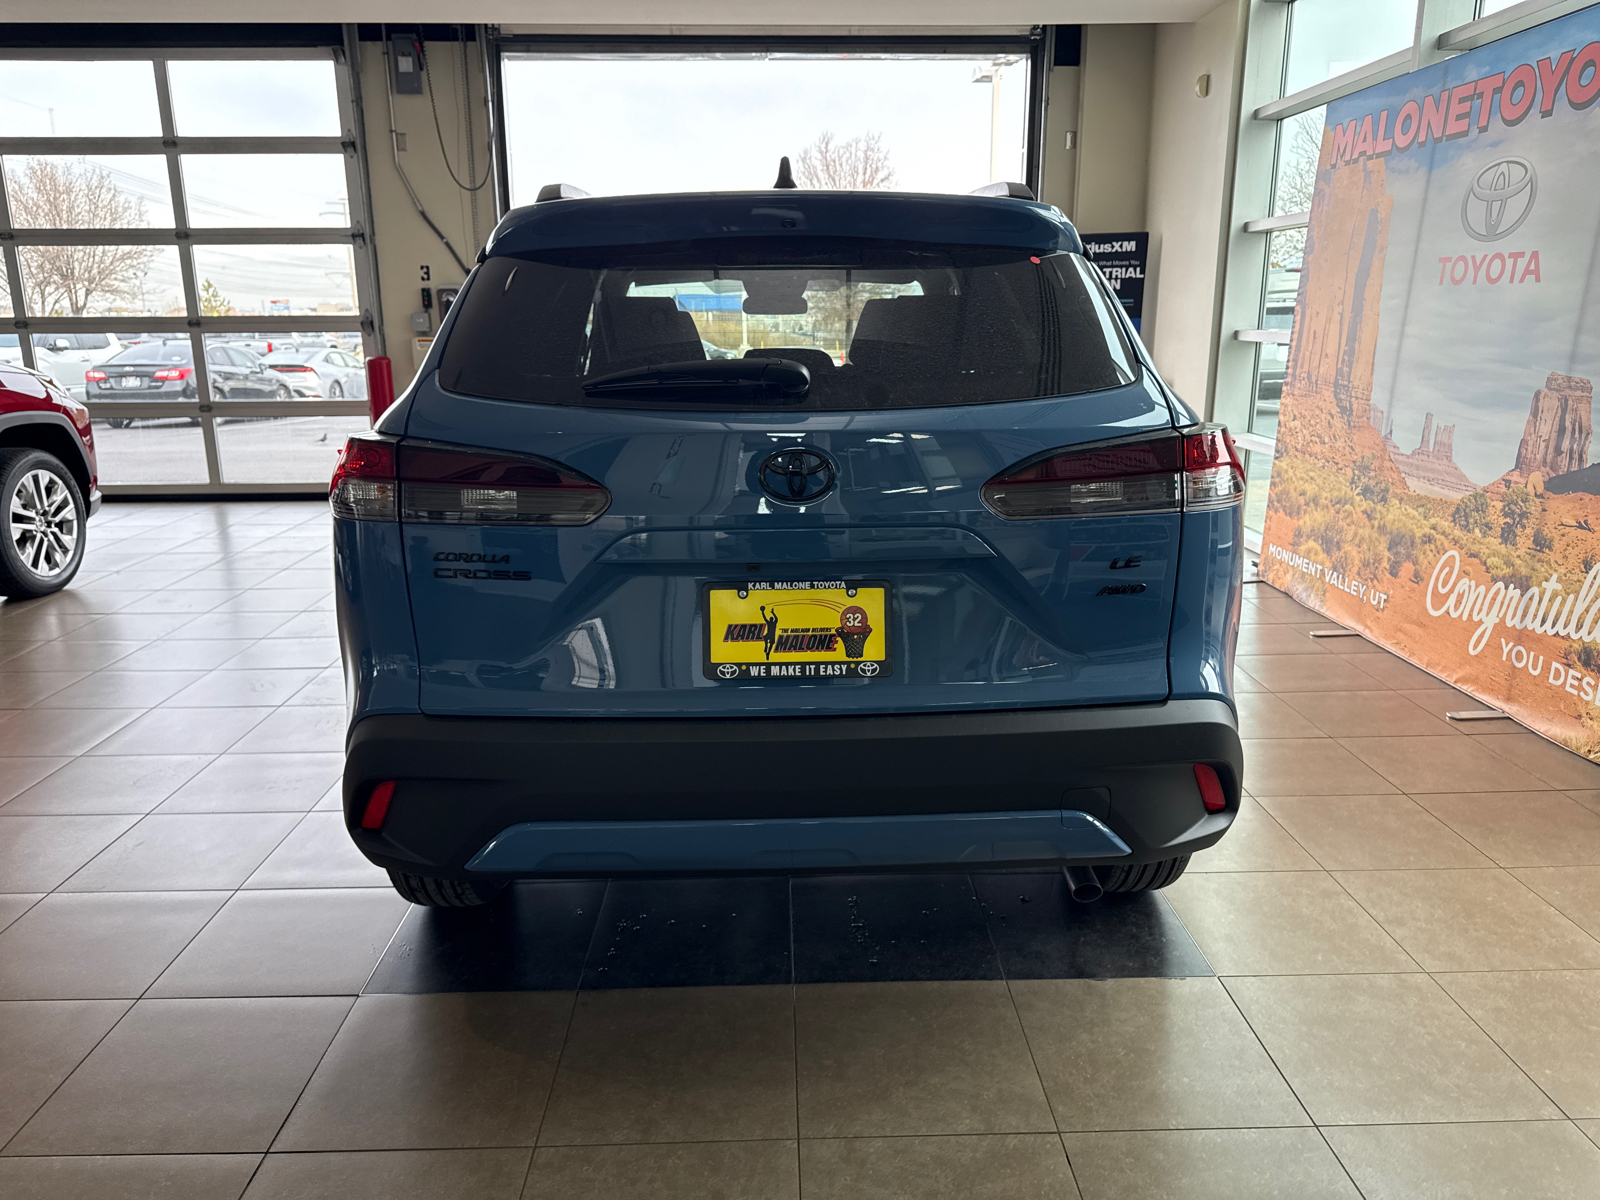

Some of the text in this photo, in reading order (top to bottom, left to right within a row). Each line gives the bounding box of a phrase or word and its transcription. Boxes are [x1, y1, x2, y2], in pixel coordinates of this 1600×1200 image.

[420, 265, 431, 281] 3
[1103, 267, 1144, 279] TRIAL
[1438, 250, 1541, 286] TOYOTA
[432, 551, 511, 564] COROLLA
[1109, 555, 1143, 570] LE
[432, 567, 532, 581] CROSS
[1268, 543, 1388, 609] MONUMENT VALLEY, UT
[747, 581, 847, 590] KARL MALONE TOYOTA
[1095, 583, 1147, 596] AWD
[846, 613, 862, 627] 32
[723, 623, 839, 653] KARL MALONE
[1500, 637, 1543, 676] YOU
[749, 664, 847, 676] WE MAKE IT EASY
